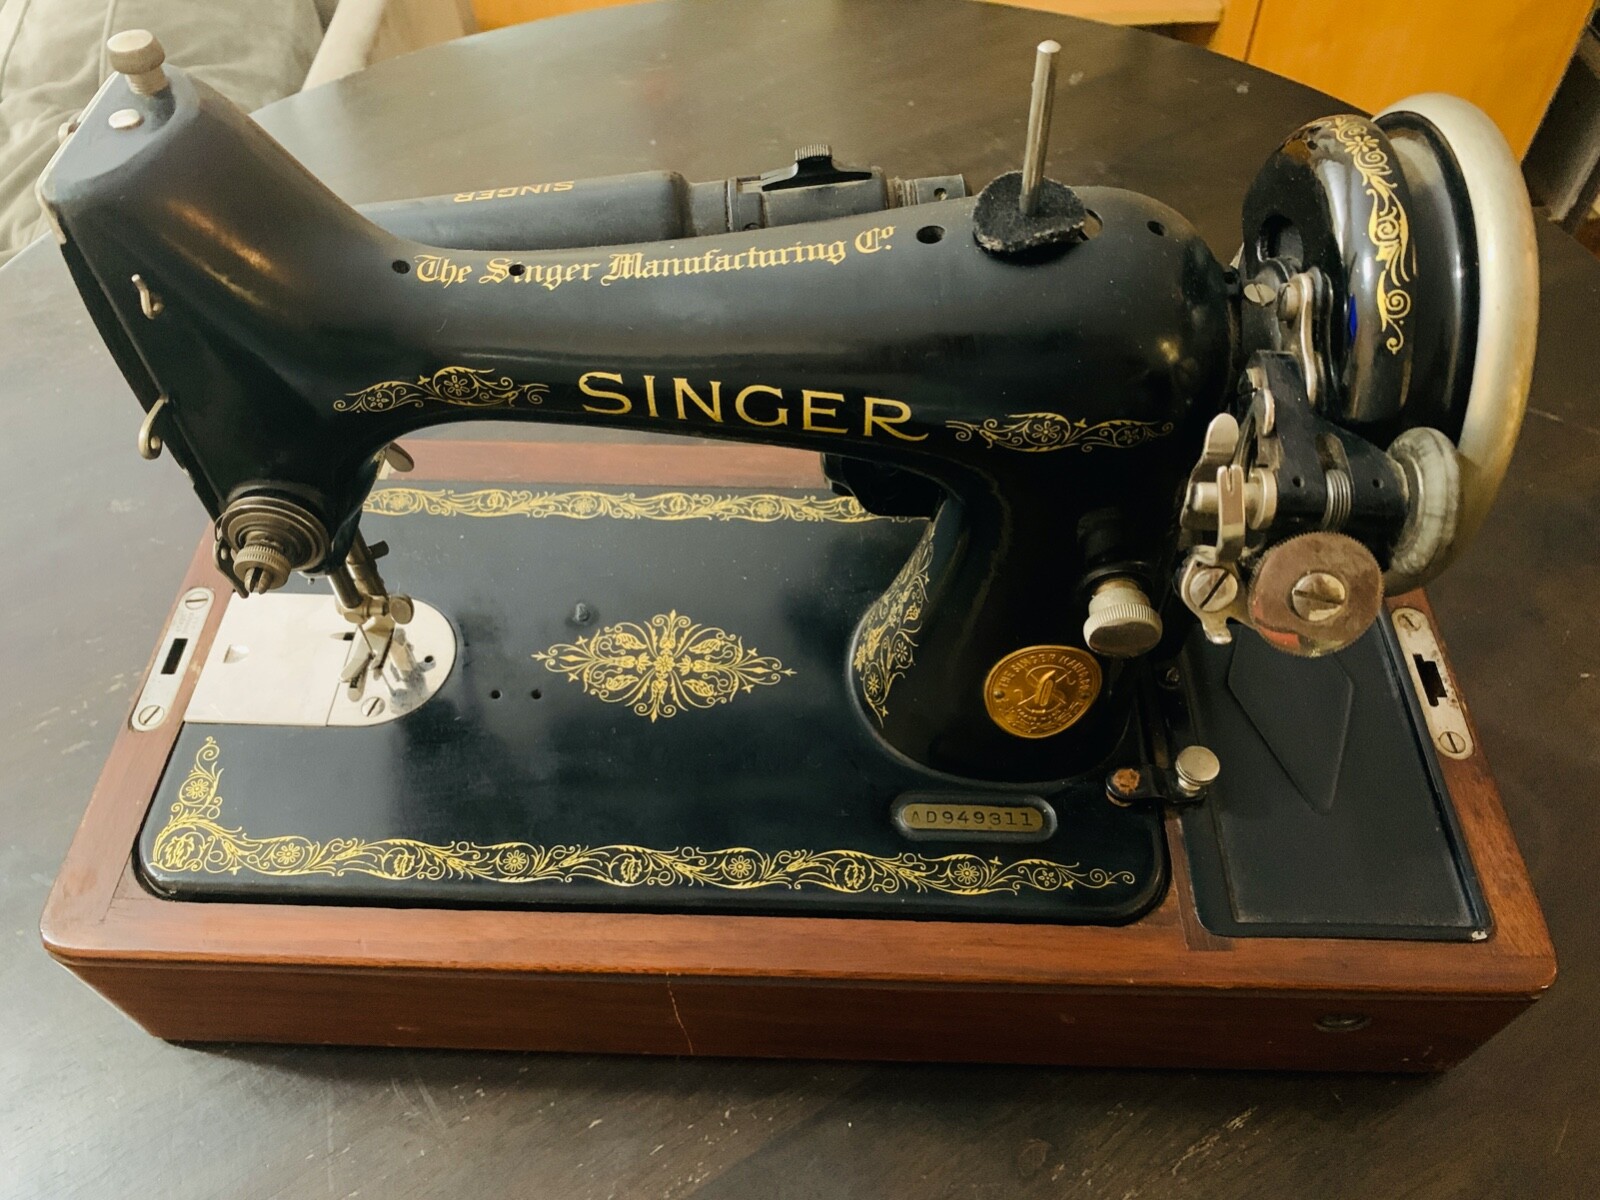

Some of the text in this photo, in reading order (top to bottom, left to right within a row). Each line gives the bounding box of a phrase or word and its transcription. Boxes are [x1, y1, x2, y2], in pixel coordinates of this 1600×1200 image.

[453, 180, 575, 203] SINGER
[414, 254, 472, 288] The
[601, 240, 848, 287] Manufacturing
[578, 370, 930, 442] SINGER
[911, 810, 1034, 827] AD949311
